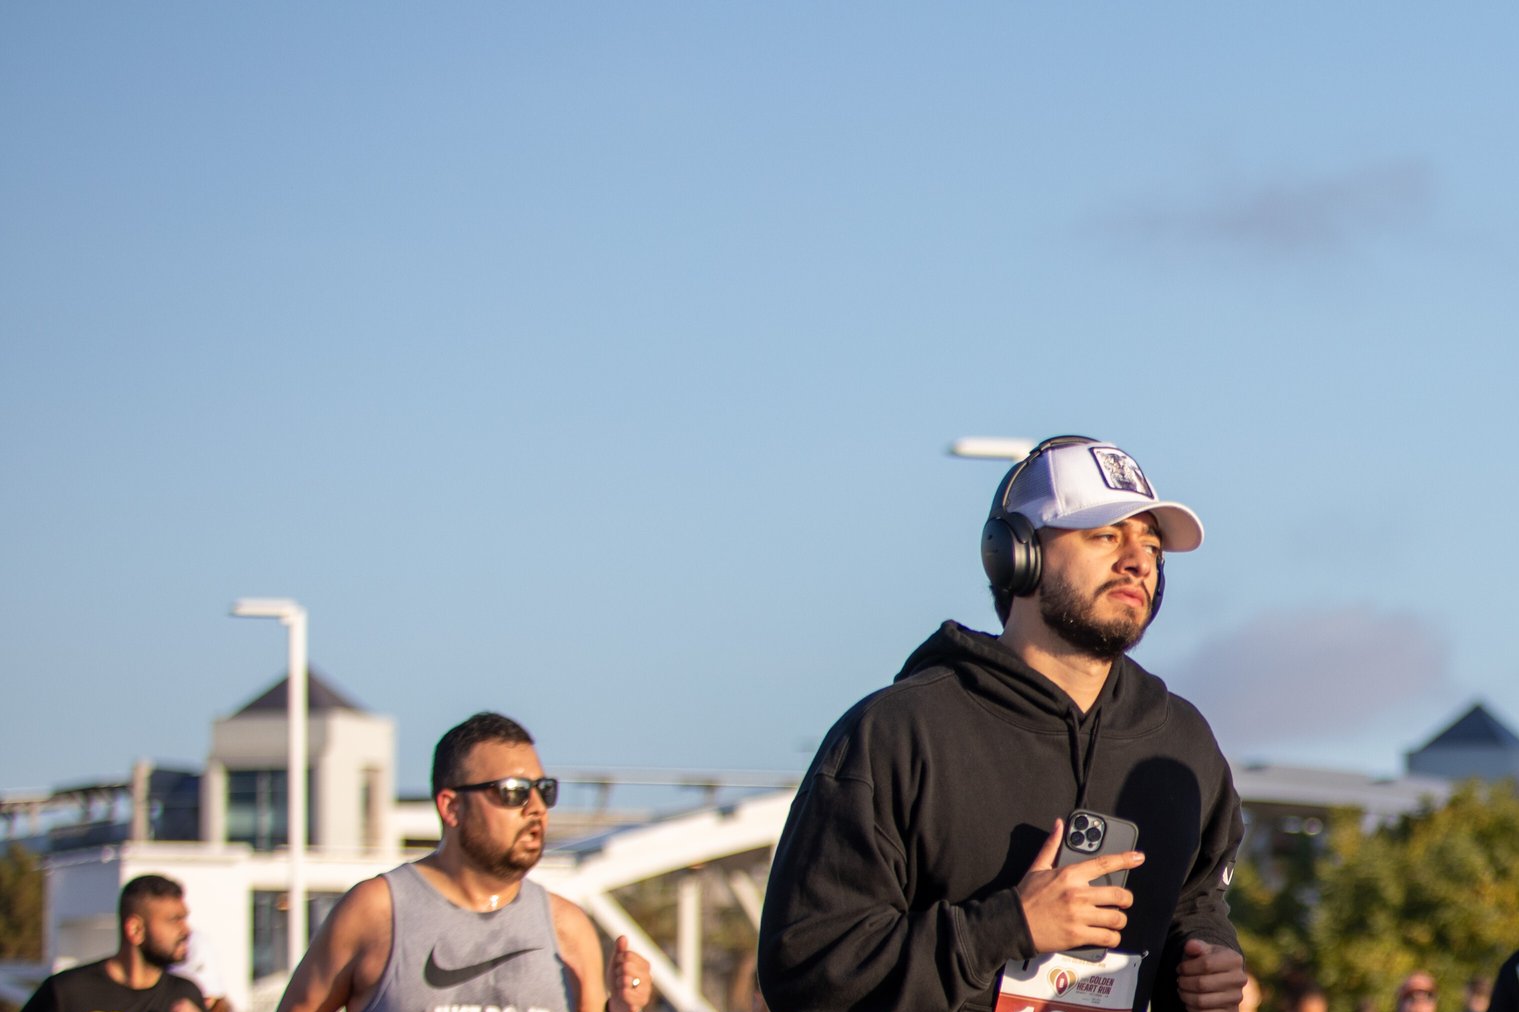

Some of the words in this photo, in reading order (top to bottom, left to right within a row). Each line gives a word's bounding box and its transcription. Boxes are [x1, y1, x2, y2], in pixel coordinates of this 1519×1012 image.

[1089, 975, 1115, 987] GOLDEN
[1076, 982, 1097, 993] HEART
[1098, 985, 1112, 995] RUN
